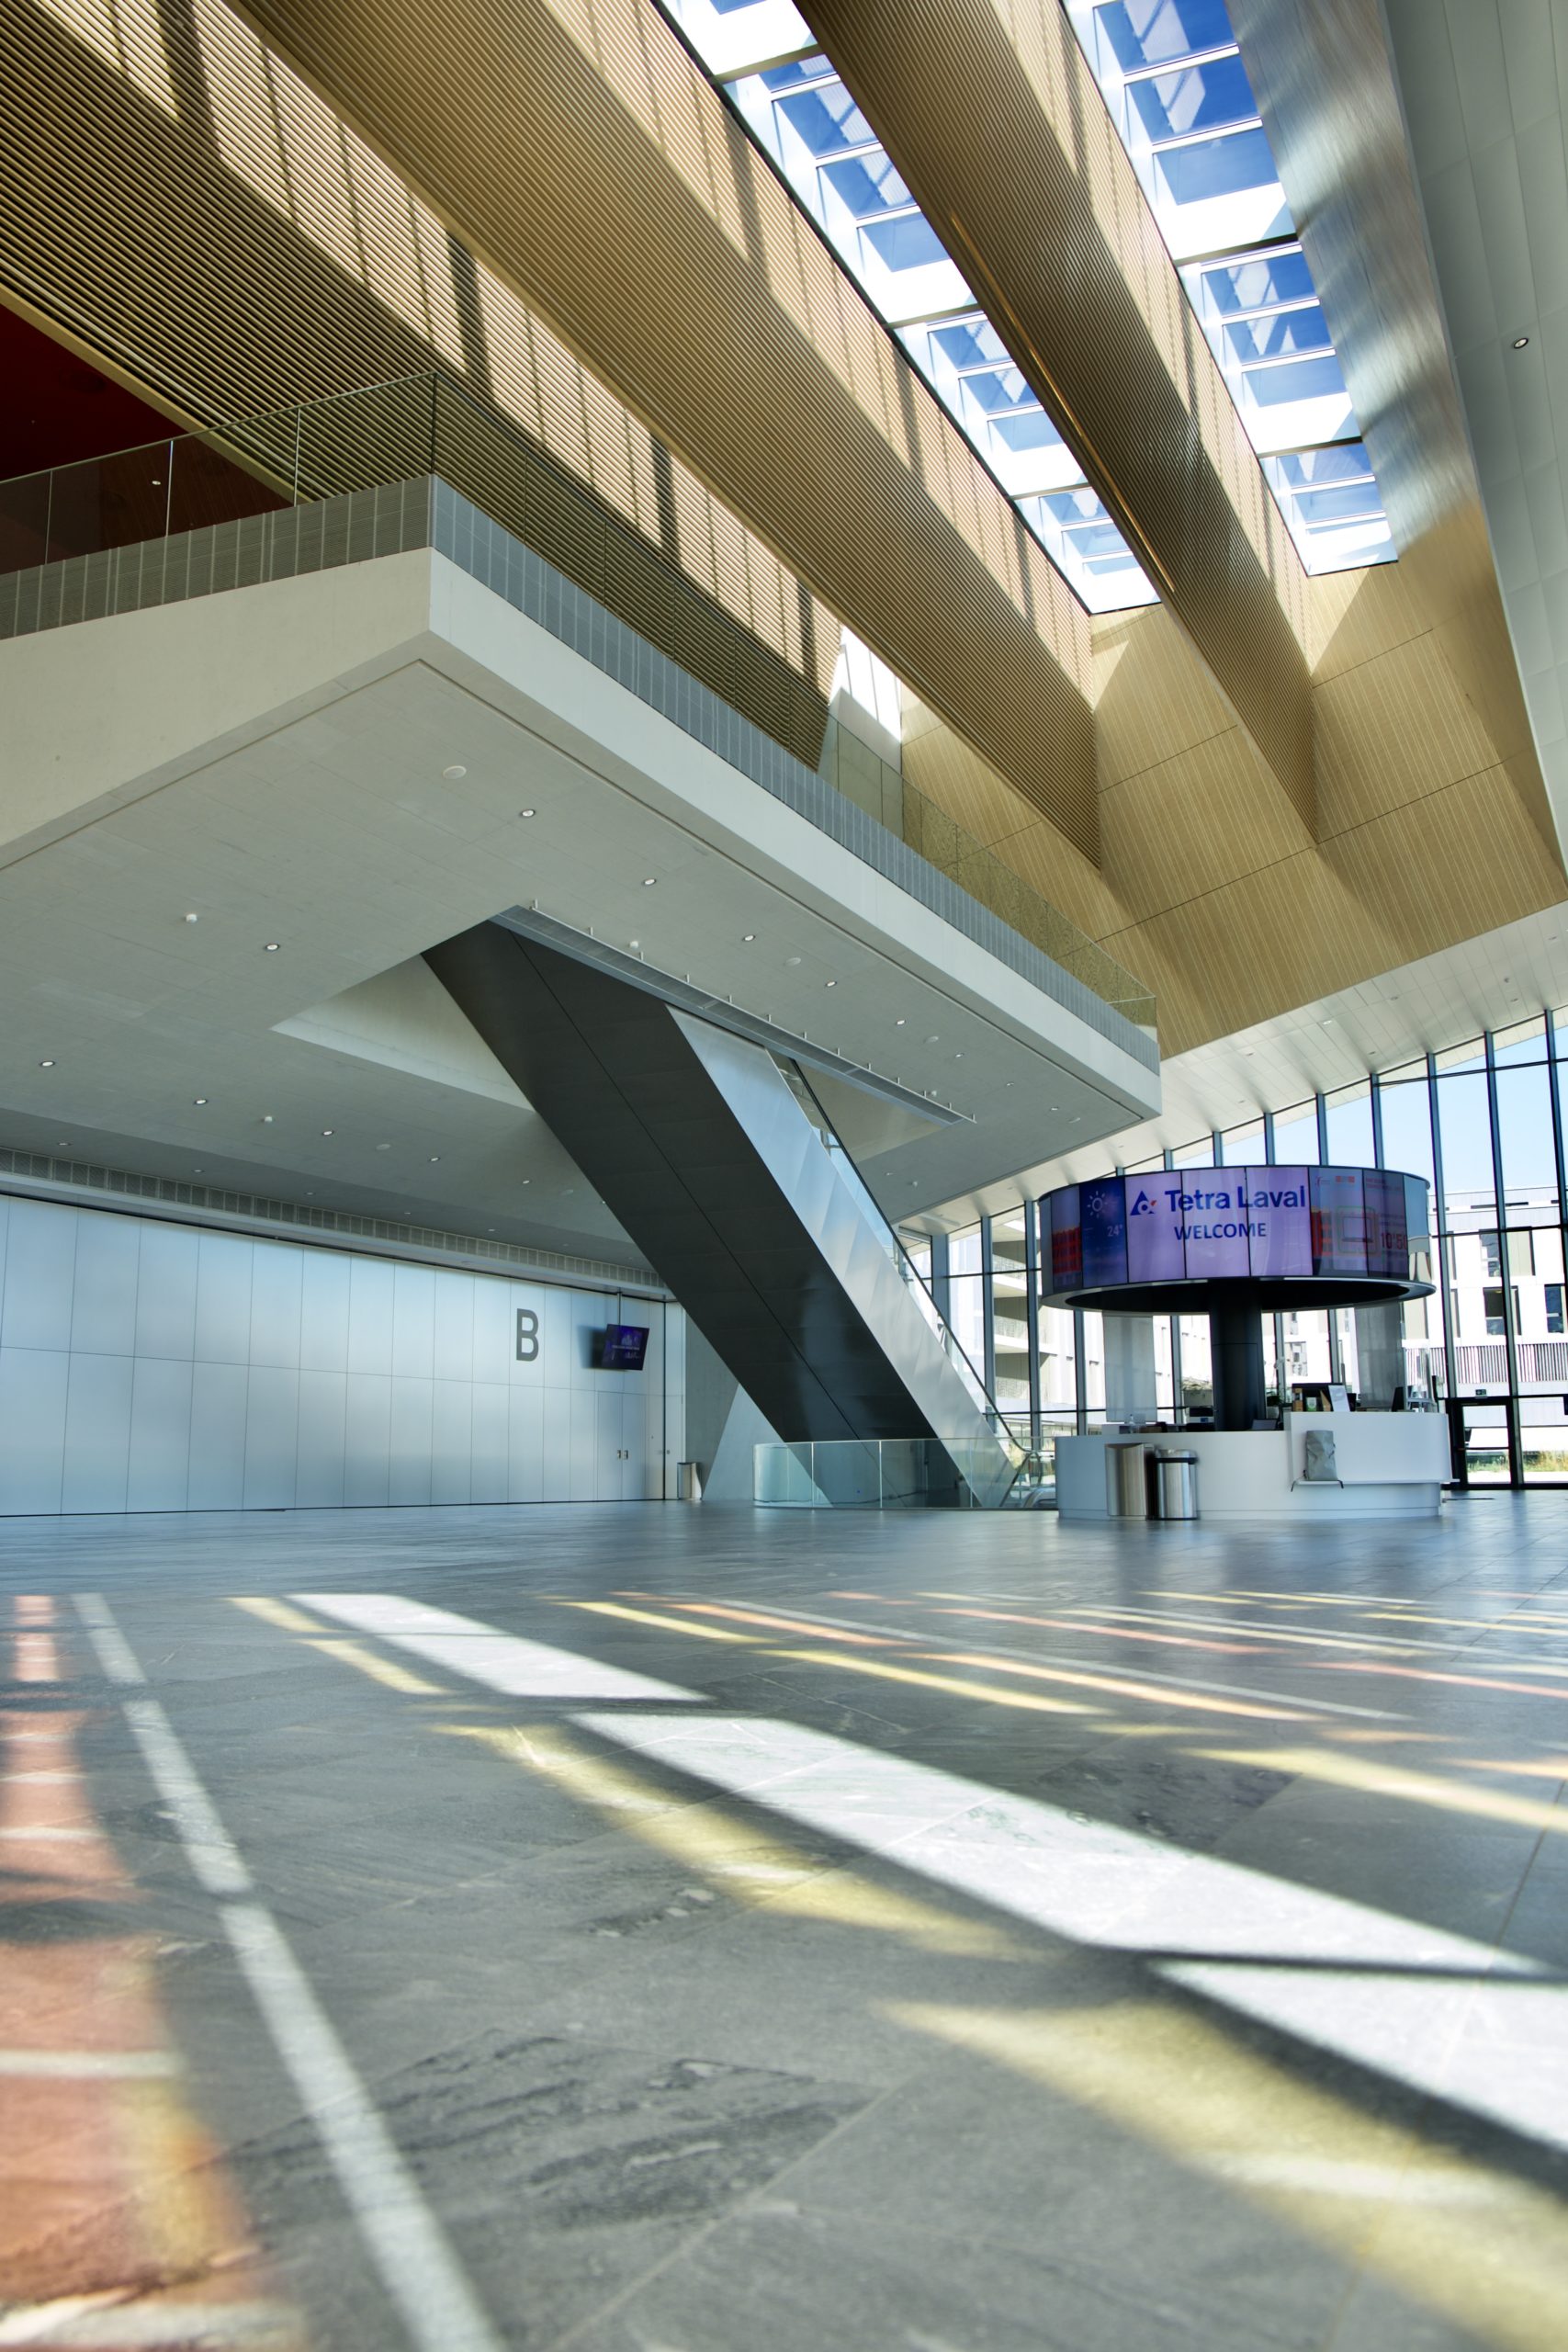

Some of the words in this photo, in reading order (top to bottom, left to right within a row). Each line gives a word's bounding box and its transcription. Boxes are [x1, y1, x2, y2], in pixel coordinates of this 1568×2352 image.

[1165, 1189, 1230, 1212] Tetra
[1237, 1185, 1305, 1209] Laval
[1174, 1223, 1267, 1240] WELCOME
[516, 1308, 539, 1362] B
